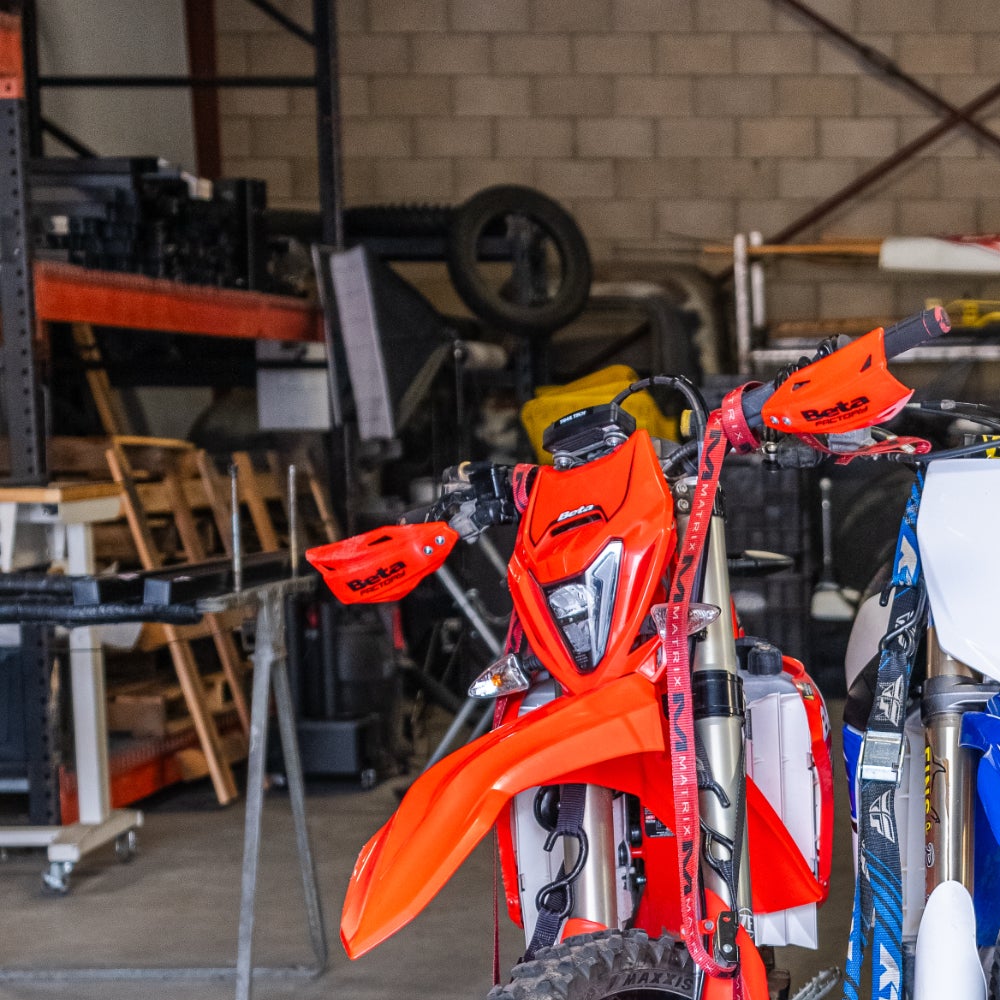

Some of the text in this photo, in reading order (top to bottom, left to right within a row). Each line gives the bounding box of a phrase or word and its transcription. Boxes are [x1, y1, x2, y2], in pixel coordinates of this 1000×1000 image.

[801, 396, 870, 422] Beta
[815, 407, 869, 427] FACTORY
[557, 504, 594, 522] Beta
[688, 483, 709, 551] MATRIX
[346, 560, 406, 591] Beta
[360, 572, 405, 596] FACTORY
[671, 606, 682, 687] MATRIX
[678, 756, 691, 836] MATRIX
[622, 971, 694, 990] MAXXIS
